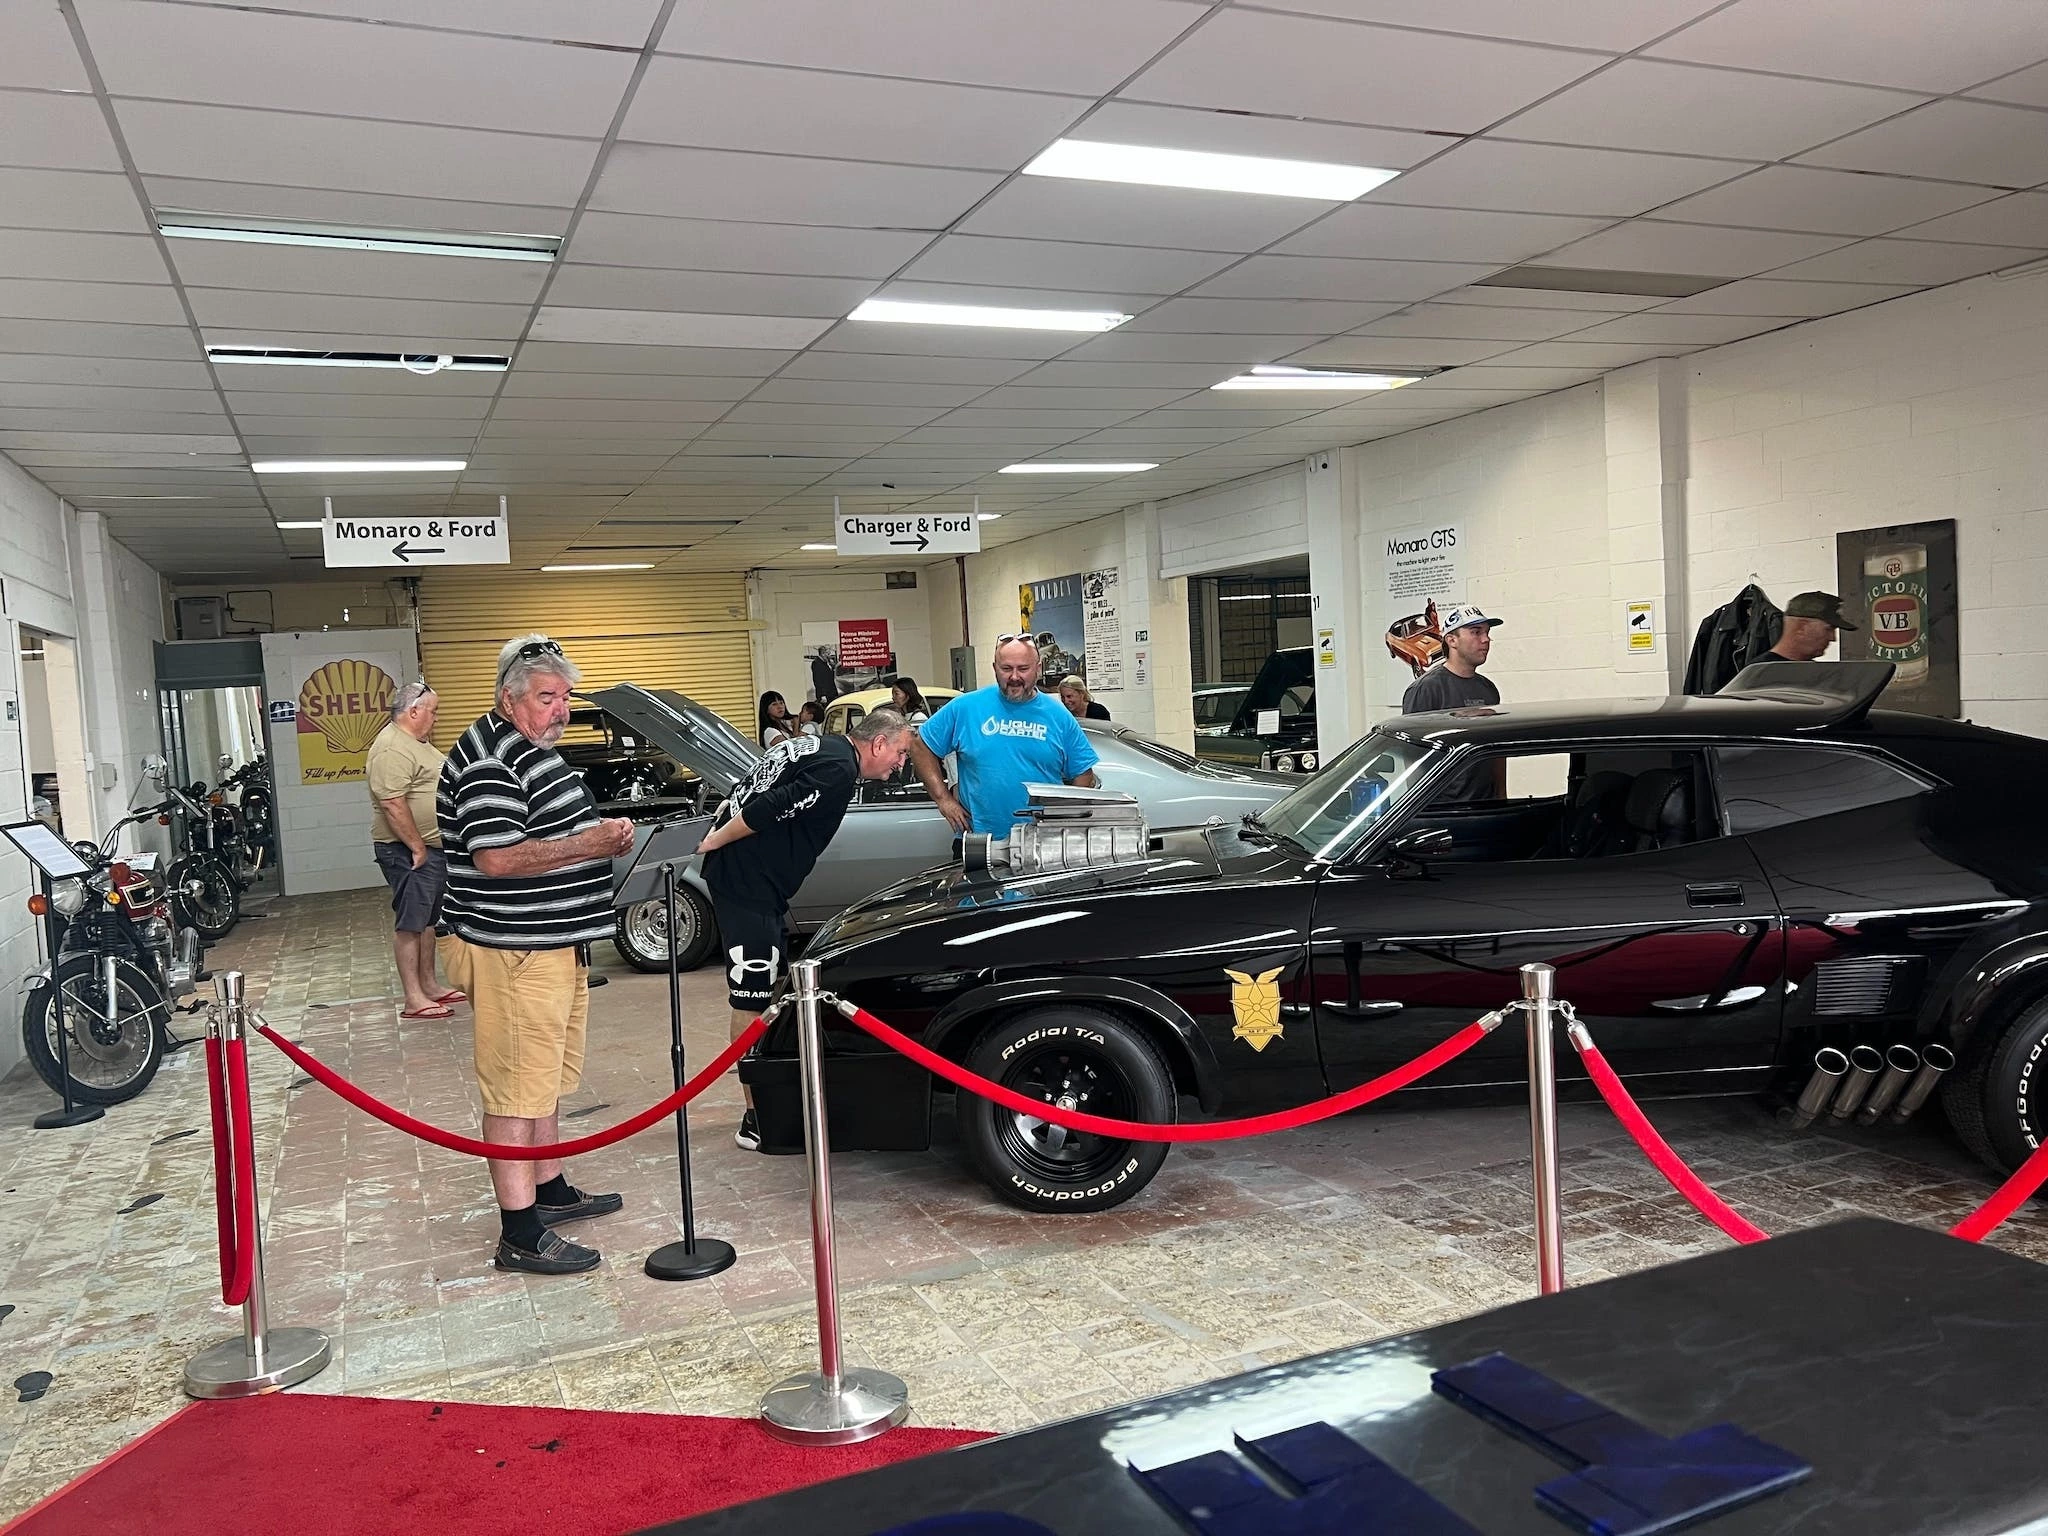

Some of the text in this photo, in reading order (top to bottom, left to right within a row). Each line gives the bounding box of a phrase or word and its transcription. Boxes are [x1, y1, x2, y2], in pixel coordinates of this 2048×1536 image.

[336, 520, 496, 539] Monaro & Ford
[844, 516, 971, 537] Charger & Ford
[1387, 528, 1456, 556] Monaro GTS
[1879, 612, 1909, 629] VB
[309, 691, 392, 717] SHELL
[999, 727, 1047, 741] CARTEL
[1000, 719, 1047, 734] LIQUID
[304, 768, 323, 780] Fill
[323, 770, 336, 780] up
[337, 766, 361, 778] from
[1001, 1026, 1105, 1060] Radial T/A
[1011, 1158, 1139, 1201] BFGoodrich
